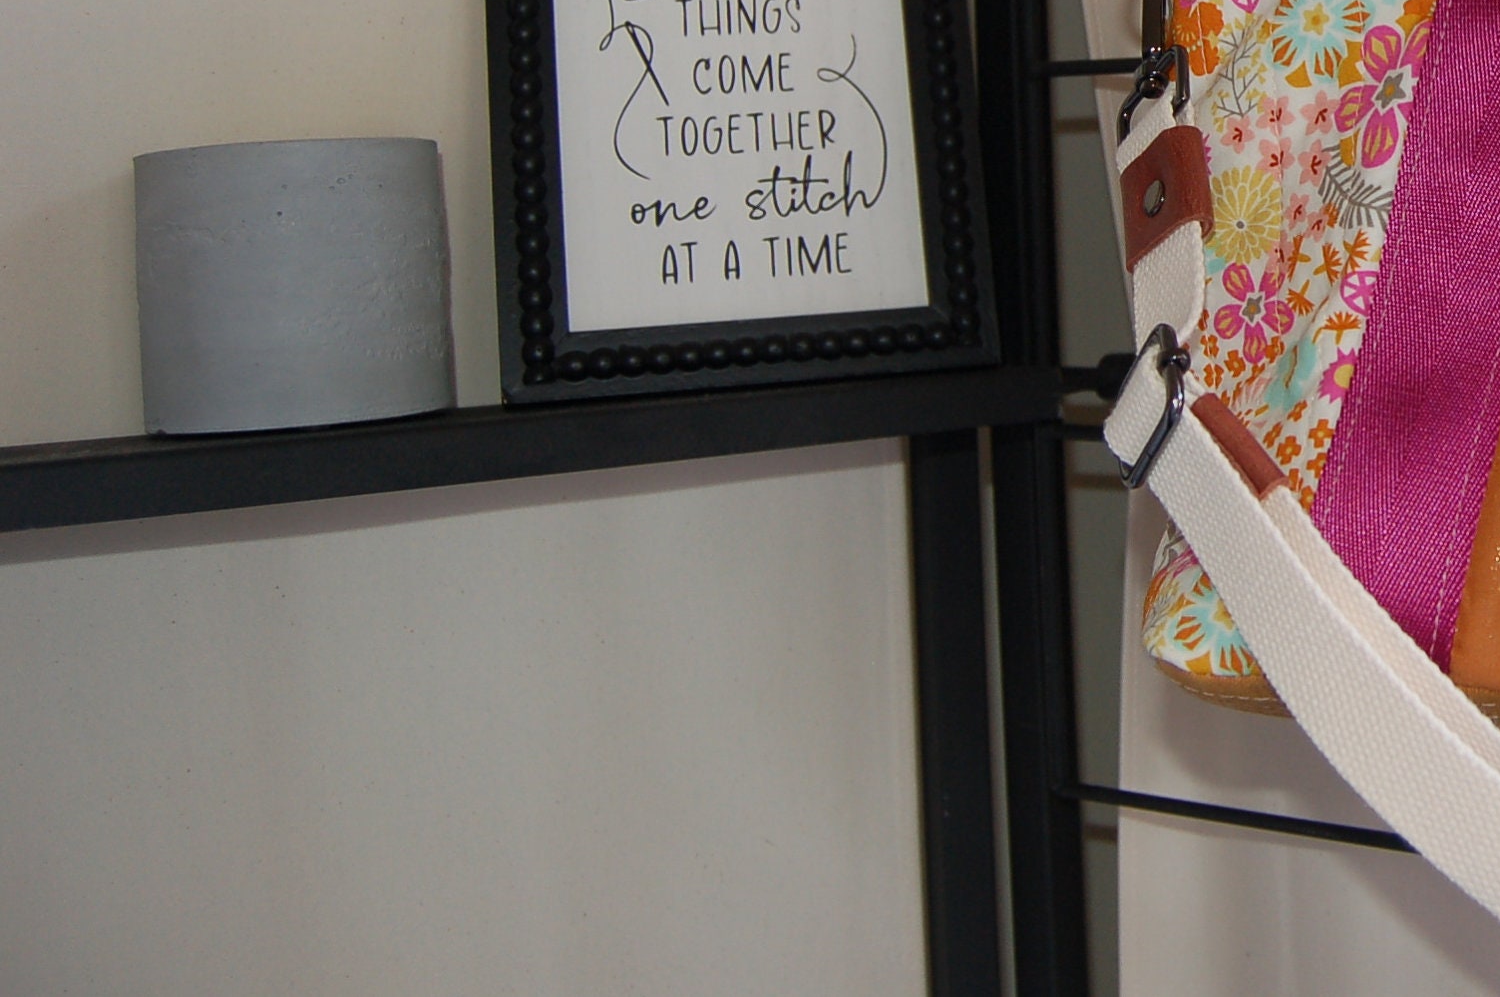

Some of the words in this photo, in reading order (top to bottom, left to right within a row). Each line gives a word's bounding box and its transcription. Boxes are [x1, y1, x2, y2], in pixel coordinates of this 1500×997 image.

[693, 53, 794, 95] COME
[656, 110, 836, 157] TOGETHER
[631, 197, 716, 227] one
[745, 150, 886, 220] stitch
[662, 242, 697, 285] AT
[724, 240, 741, 280] A
[763, 233, 852, 278] TIME
